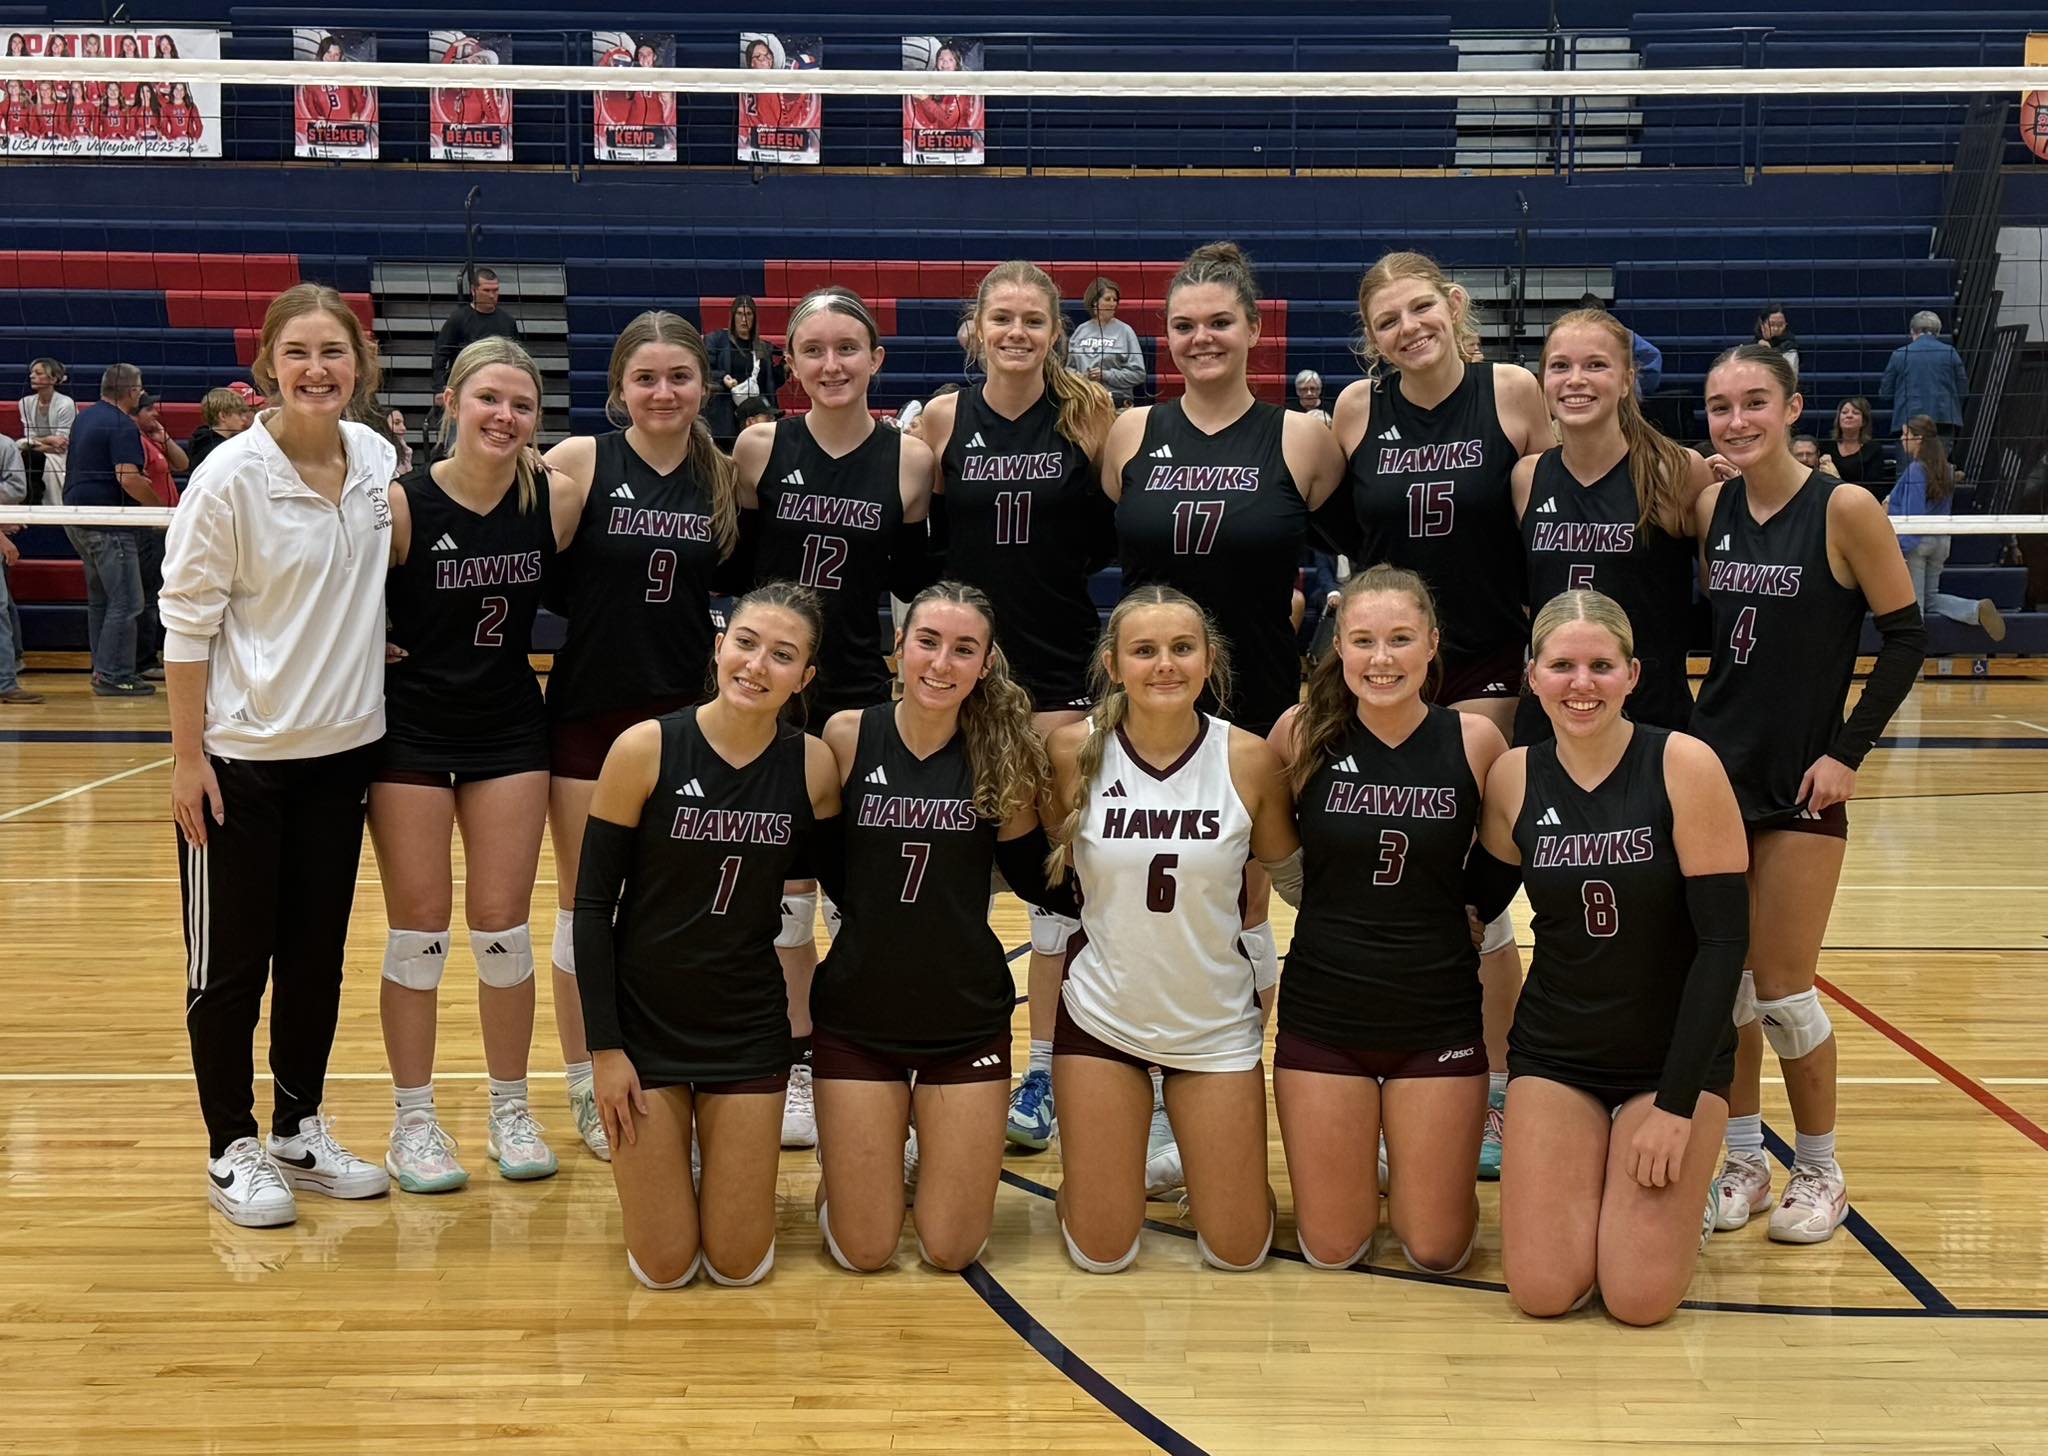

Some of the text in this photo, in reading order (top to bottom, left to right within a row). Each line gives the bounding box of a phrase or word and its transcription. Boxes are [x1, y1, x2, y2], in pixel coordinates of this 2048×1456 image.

[12, 139, 37, 151] USA
[87, 140, 144, 155] Volleyball
[145, 141, 194, 153] 2025-26
[308, 128, 365, 143] STECKER
[446, 130, 501, 144] BEAGLE
[615, 131, 656, 146] KEMP
[757, 132, 804, 147] GREEN
[961, 451, 1063, 481] HAWKS
[1377, 439, 1482, 475] HAWKS
[1144, 465, 1259, 492] HAWKS
[608, 506, 712, 543] HAWKS
[776, 492, 882, 531] HAWKS
[994, 491, 1032, 545] 11
[1172, 500, 1226, 555] 17
[1406, 481, 1455, 538] 15
[1532, 521, 1635, 552] HAWKS
[436, 550, 542, 589] HAWKS
[645, 548, 677, 603] 9
[800, 533, 848, 590] 12
[1709, 560, 1803, 598] HAWKS
[474, 596, 509, 647] 2
[1730, 606, 1757, 665] 4
[858, 793, 977, 832] HAWKS
[1325, 780, 1457, 820] HAWKS
[671, 806, 792, 846] HAWKS
[1102, 807, 1220, 840] HAWKS
[1373, 829, 1409, 886] 3
[1533, 826, 1654, 869] HAWKS
[711, 856, 743, 915] 1
[900, 842, 931, 903] 7
[1146, 853, 1179, 914] 6
[1581, 880, 1619, 938] 8
[1451, 1047, 1475, 1059] asics
